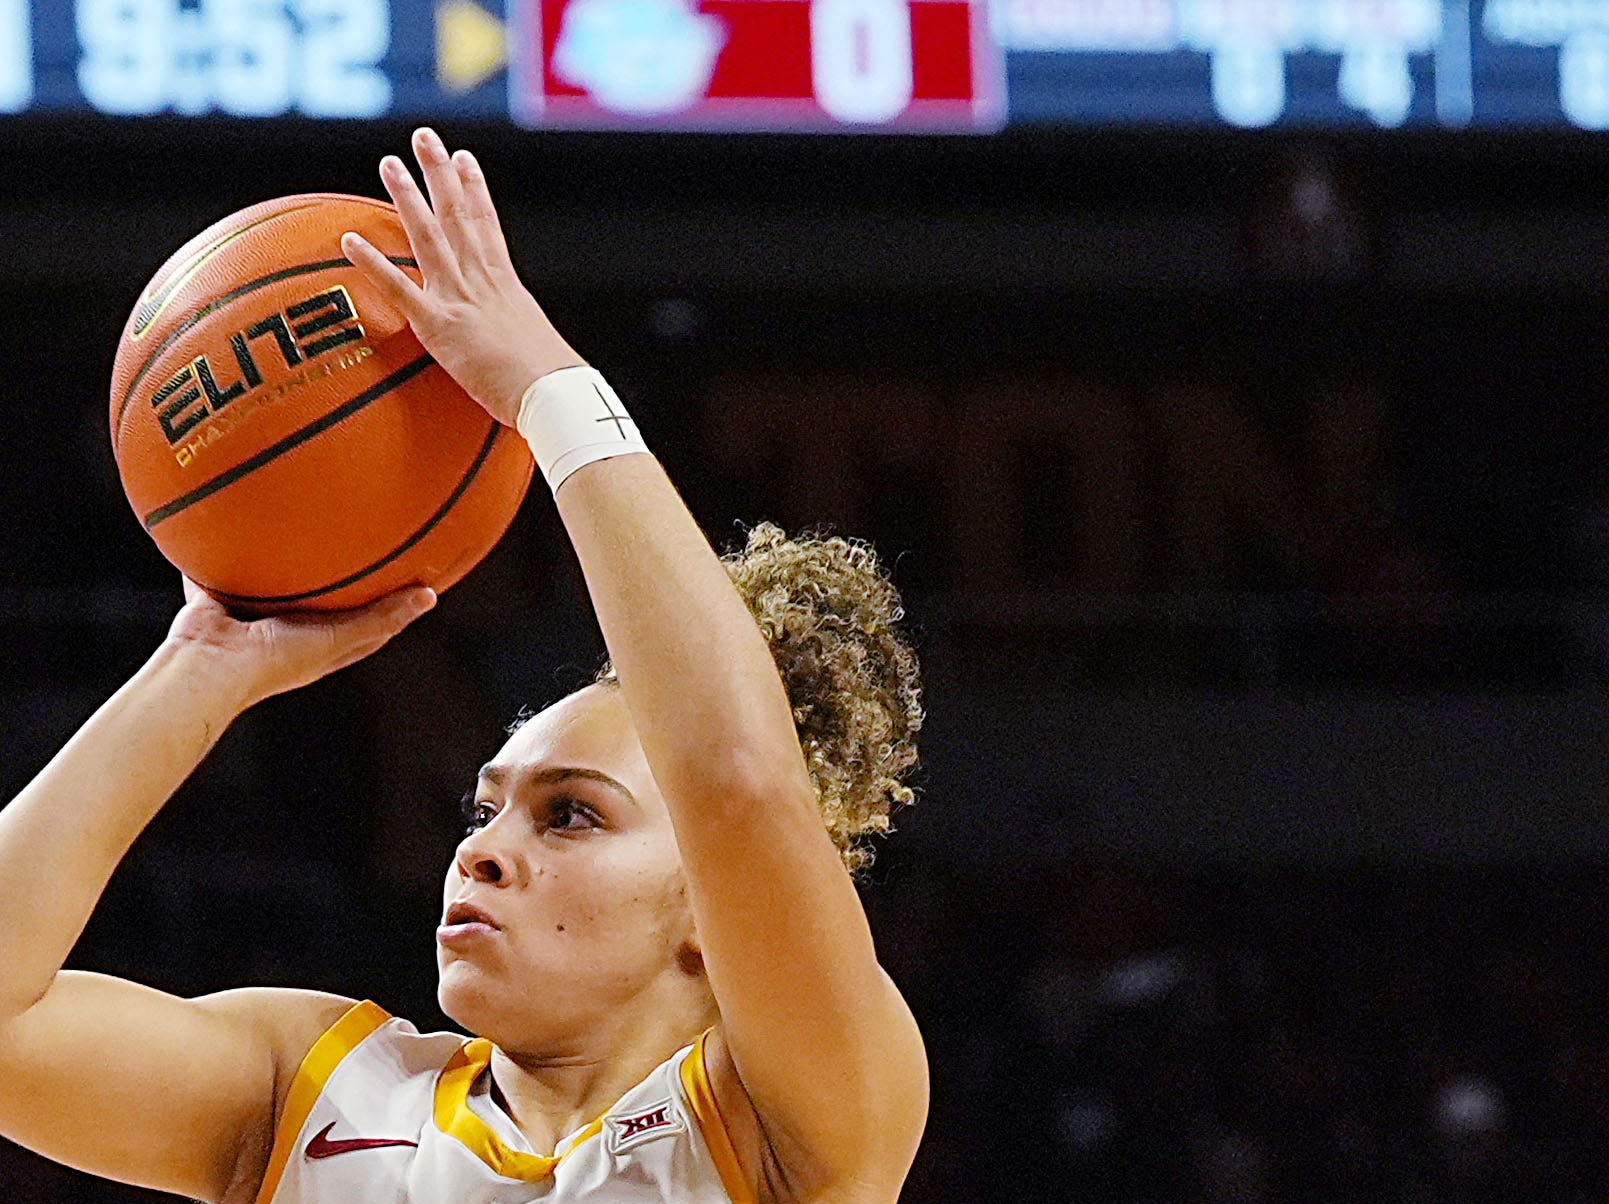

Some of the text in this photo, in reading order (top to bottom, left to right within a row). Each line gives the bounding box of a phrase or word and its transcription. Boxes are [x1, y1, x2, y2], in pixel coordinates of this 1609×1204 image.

[76, 0, 393, 117] 9:52
[810, 0, 913, 122] 0
[150, 284, 366, 447] ELITE
